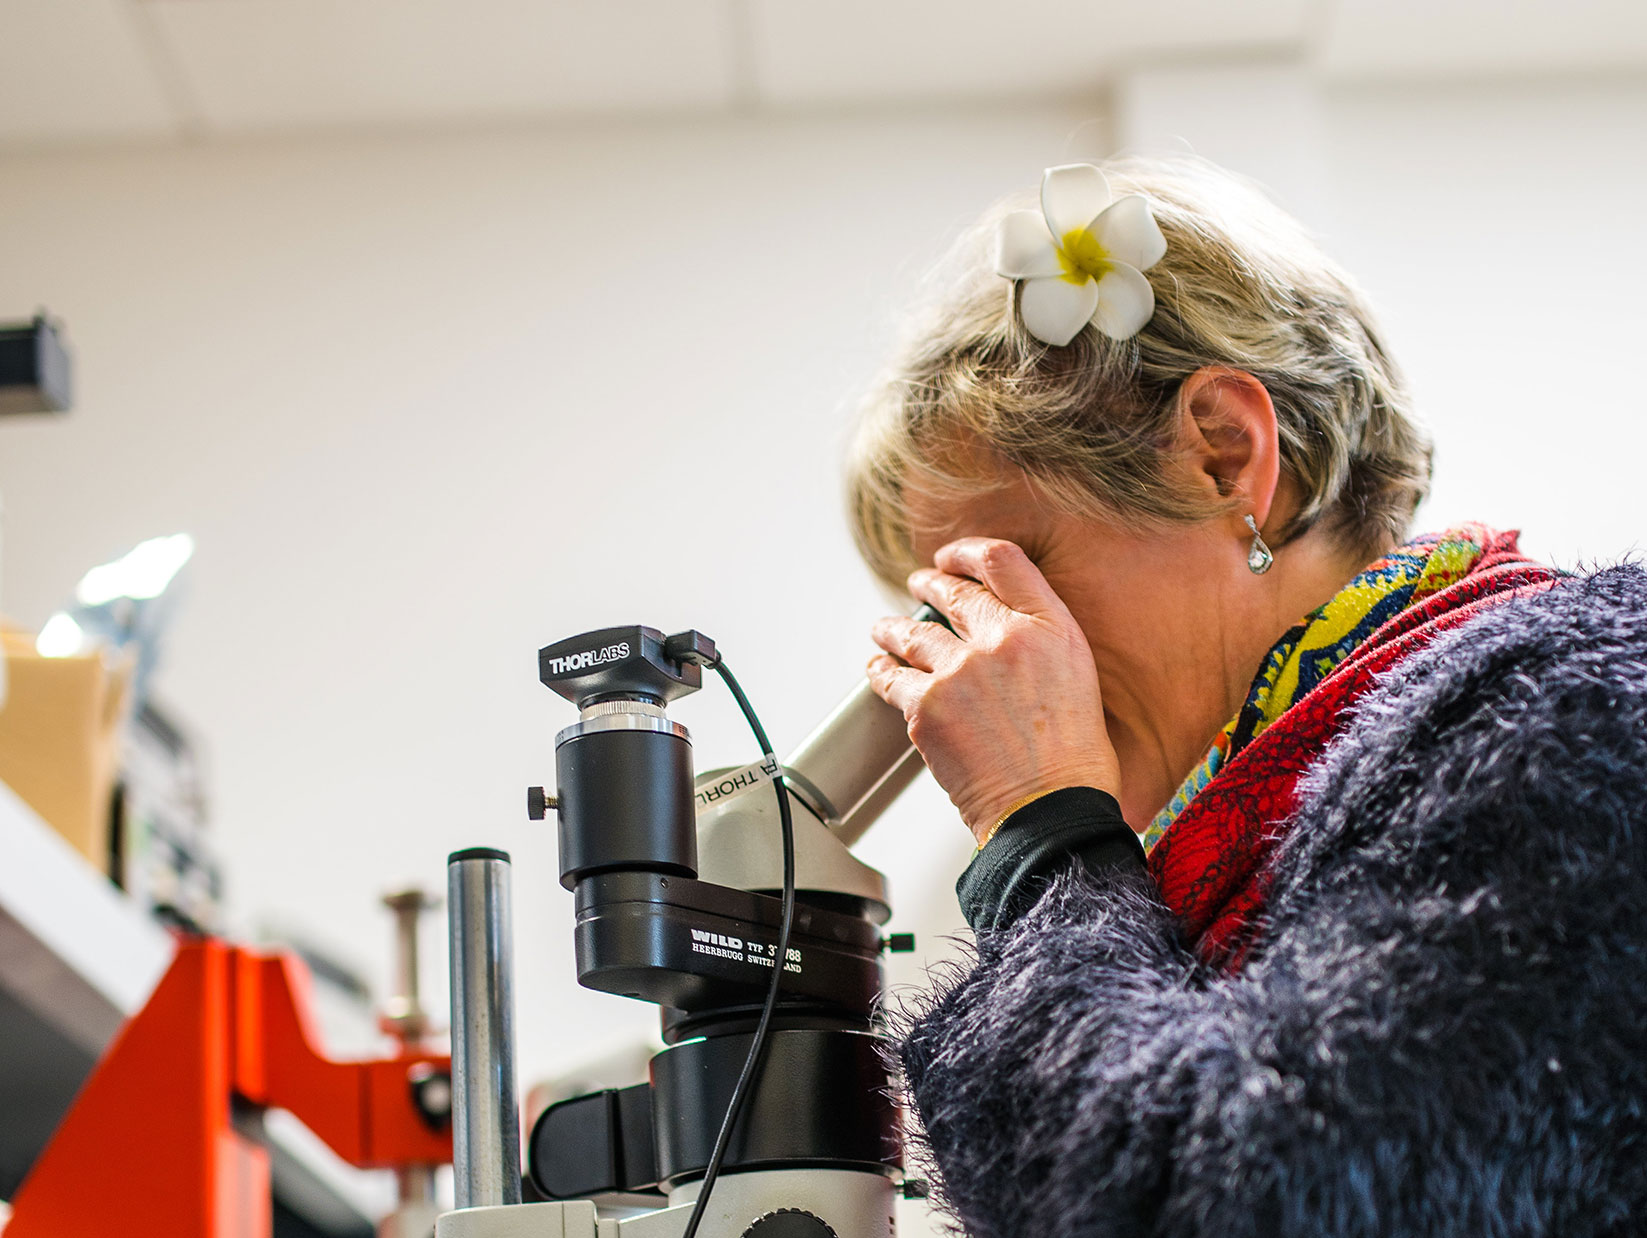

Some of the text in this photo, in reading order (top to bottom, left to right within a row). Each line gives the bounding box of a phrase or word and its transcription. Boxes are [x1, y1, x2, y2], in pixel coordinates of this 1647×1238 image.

[549, 642, 630, 674] THORLABS
[691, 928, 743, 950] WILD
[747, 942, 764, 953] TYP
[692, 942, 744, 962] HEERBRUGG
